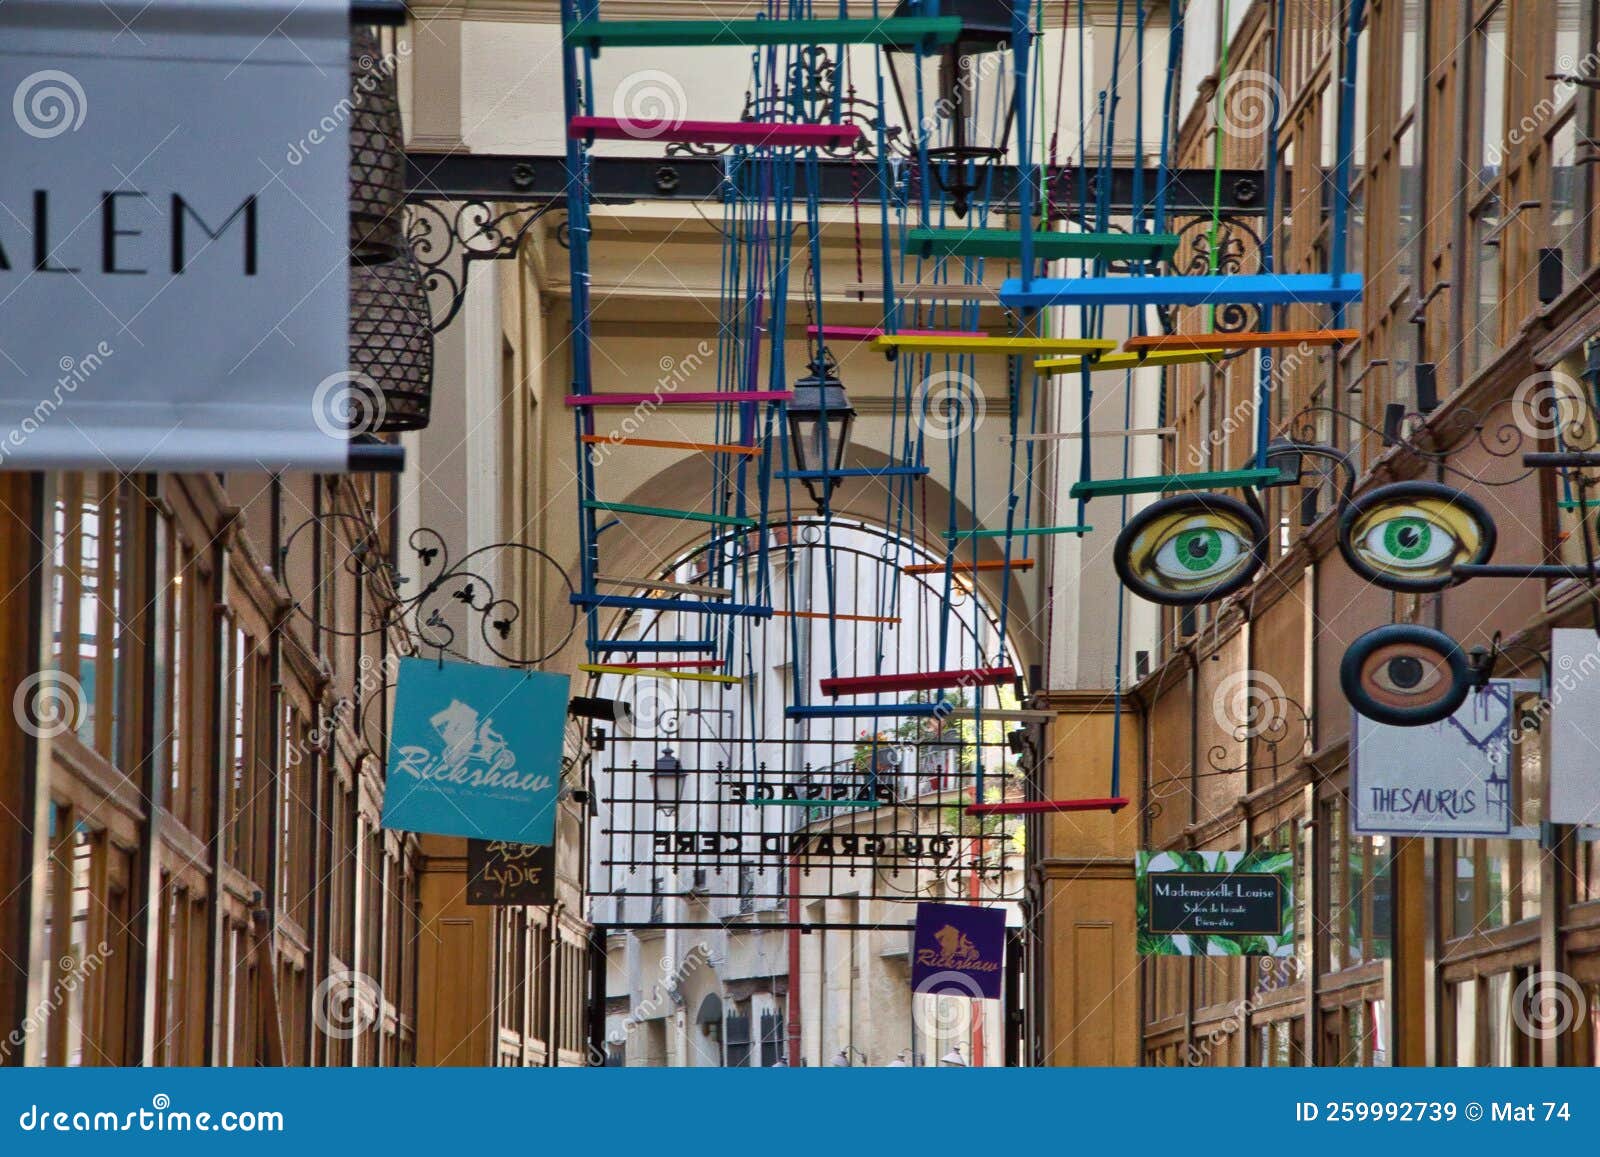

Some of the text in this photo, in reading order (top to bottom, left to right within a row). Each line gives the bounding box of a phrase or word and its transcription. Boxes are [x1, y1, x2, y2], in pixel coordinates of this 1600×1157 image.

[0, 188, 258, 276] LEM
[393, 746, 553, 792] Rickshaw
[1370, 787, 1476, 820] THESAURUS
[1155, 883, 1275, 898] Mademoiselle Louise
[1183, 903, 1208, 913] Salon
[1209, 903, 1219, 913] de
[916, 948, 999, 972] Rickshaw
